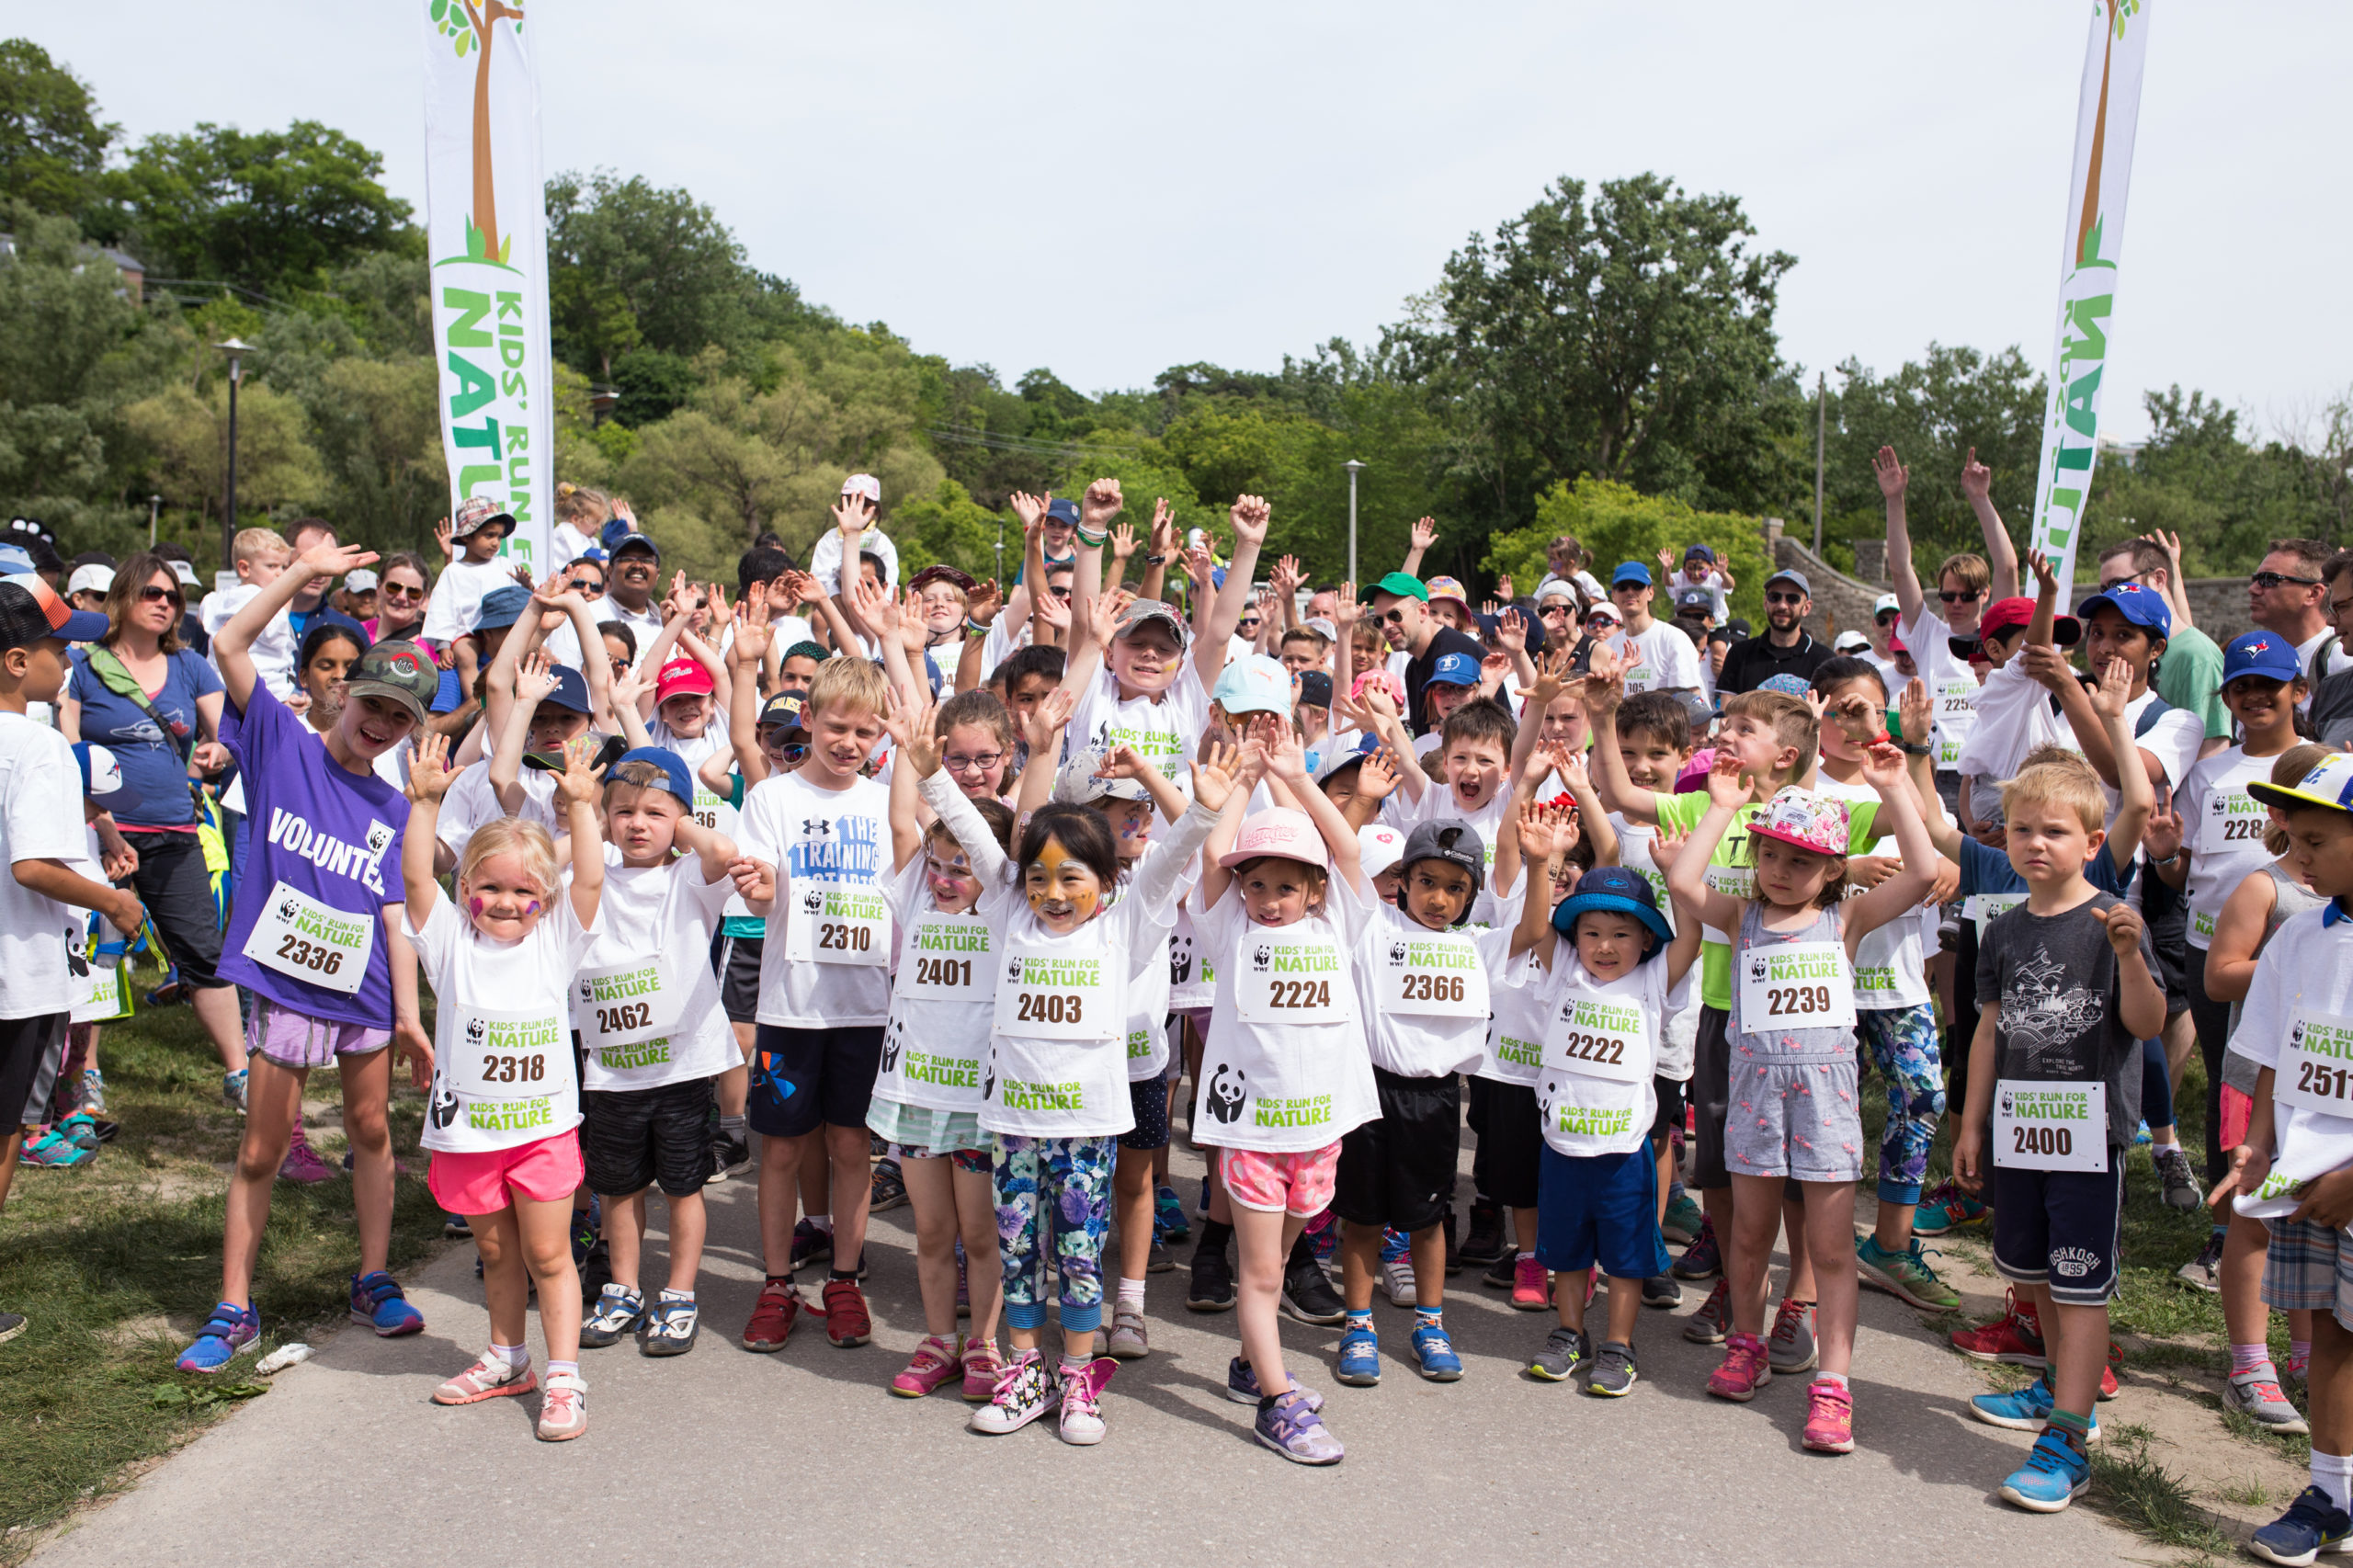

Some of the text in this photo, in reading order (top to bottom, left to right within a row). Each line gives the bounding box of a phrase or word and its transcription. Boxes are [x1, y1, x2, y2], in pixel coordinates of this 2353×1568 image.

[496, 290, 528, 413] KIDS'
[506, 426, 531, 523] RUN
[1109, 728, 1141, 742] KIDS'
[2228, 801, 2268, 814] NATU
[844, 815, 878, 843] THE
[2224, 818, 2269, 840] 228
[796, 841, 880, 872] TRAINING
[1719, 876, 1740, 886] KIDS'
[825, 892, 851, 902] KIDS'
[853, 892, 870, 903] RUN
[871, 894, 884, 905] FOR
[275, 914, 290, 926] WWF
[301, 906, 366, 934] KIDS' RUN FOR
[824, 902, 883, 920] NATURE
[295, 915, 364, 949] NATURE
[819, 923, 870, 952] 2310
[921, 924, 990, 936] KIDS' RUN FOR
[920, 935, 990, 952] NATURE
[1274, 946, 1302, 955] KIDS'
[1304, 945, 1324, 954] RUN
[1409, 942, 1474, 954] KIDS' RUN FOR
[276, 934, 343, 975] 2336
[1024, 957, 1100, 969] KIDS' RUN FOR
[1274, 956, 1339, 972] NATURE
[1409, 952, 1477, 970] NATURE
[1768, 952, 1836, 963] KIDS' RUN FOR
[591, 966, 657, 987] KIDS' RUN FOR
[915, 957, 972, 986] 2401
[1023, 969, 1100, 987] NATURE
[1770, 962, 1839, 982] NATURE
[1878, 966, 1895, 975] FOR
[593, 976, 662, 1002] NATURE
[1269, 980, 1331, 1008] 2224
[1402, 973, 1464, 1002] 2366
[1017, 993, 1083, 1024] 2403
[1576, 1000, 1640, 1018] KIDS' RUN FOR
[1768, 985, 1831, 1016] 2239
[488, 1016, 558, 1031] KIDS' RUN FOR
[597, 1001, 653, 1034] 2462
[1574, 1010, 1640, 1034] NATURE
[487, 1027, 559, 1048] NATURE
[1129, 1029, 1149, 1042] FOR
[2307, 1022, 2333, 1036] KIDS'
[466, 1038, 482, 1046] WWF
[648, 1037, 669, 1049] FOR
[1500, 1035, 1542, 1052] KIDS' RUN
[1565, 1031, 1625, 1065] 2222
[600, 1046, 671, 1070] NATURE
[905, 1050, 979, 1069] KIDS' RUN FOR
[482, 1053, 545, 1083] 2318
[904, 1062, 979, 1088] NATURE
[1003, 1078, 1082, 1093] KIDS' RUN FOR
[469, 1096, 551, 1113] KIDS' RUN FOR
[1003, 1089, 1084, 1111] NATURE
[1256, 1094, 1332, 1109] KIDS' RUN FOR
[2014, 1091, 2087, 1101] KIDS' RUN FOR
[470, 1107, 553, 1131] NATURE
[1256, 1105, 1332, 1128] NATURE
[1560, 1105, 1633, 1119] KIDS' RUN FOR
[2015, 1102, 2088, 1120] NATURE
[1560, 1117, 1632, 1136] NATURE
[2013, 1126, 2073, 1156] 2400
[2050, 1246, 2101, 1270] OSHKOSH
